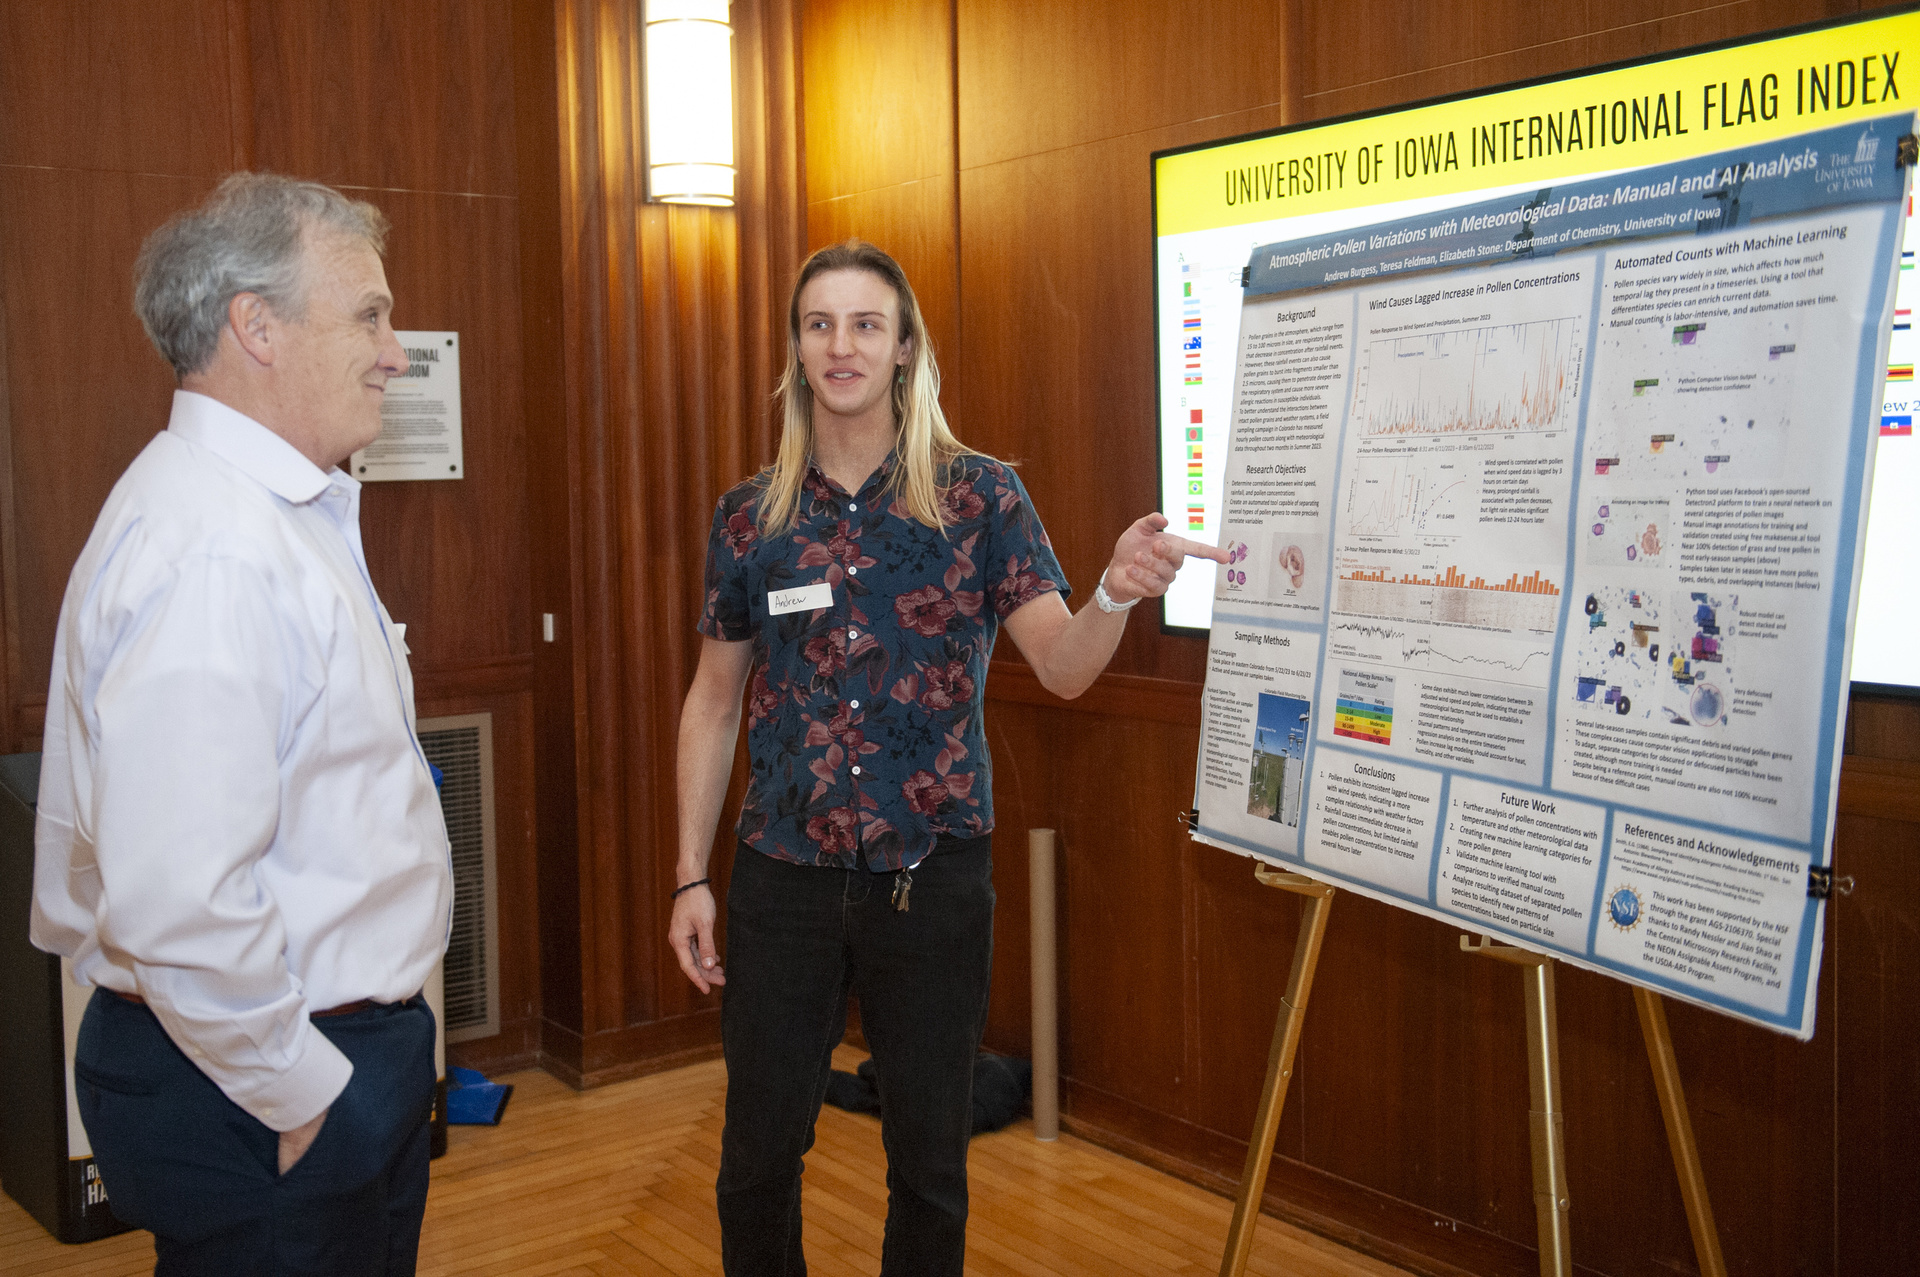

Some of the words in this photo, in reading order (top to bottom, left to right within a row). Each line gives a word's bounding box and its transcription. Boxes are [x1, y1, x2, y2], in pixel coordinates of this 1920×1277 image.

[1226, 150, 1347, 206] UNIVERSITY
[1358, 144, 1383, 185] OF
[1396, 131, 1459, 180] IOWA
[1472, 89, 1688, 168] INTERNATIONAL
[1703, 73, 1778, 131] FLAG
[1797, 51, 1900, 116] INDEX
[1831, 153, 1850, 167] THE
[1815, 164, 1875, 183] UNIVERSITY
[1827, 181, 1838, 193] OF
[1844, 177, 1873, 191] IOWA
[1268, 244, 1331, 269] Atmospheric
[1331, 236, 1367, 255] Pollen
[1367, 229, 1426, 249] Variations
[1427, 217, 1459, 240] with
[1459, 196, 1566, 232] Meteorological
[1566, 189, 1611, 213] Data:
[1611, 177, 1678, 205] Manual
[1678, 171, 1718, 195] and
[1717, 166, 1741, 189] AI
[1741, 152, 1819, 182] Analysis
[1323, 269, 1349, 282] Andrew
[1349, 265, 1378, 278] Burgess,
[1379, 261, 1402, 272] Teresa
[1403, 255, 1437, 268] Feldman,
[1438, 245, 1476, 263] Elizabeth
[1476, 241, 1503, 256] Stone:
[1504, 232, 1558, 252] Department
[1559, 228, 1570, 242] of
[1571, 223, 1621, 239] Chemistry,
[1623, 213, 1676, 231] University
[1678, 207, 1692, 223] of
[1693, 207, 1721, 220] Iowa
[1614, 250, 1673, 270] Automated
[1675, 247, 1713, 261] Counts
[1715, 240, 1740, 256] with
[1742, 235, 1793, 252] Machine
[1796, 227, 1846, 244] Learning
[1613, 279, 1634, 289] Pollen
[1635, 277, 1660, 287] species
[1661, 274, 1678, 282] vary
[1679, 269, 1704, 279] widely
[1731, 262, 1754, 273] which
[1756, 260, 1781, 270] affects
[1783, 257, 1801, 266] how
[1802, 252, 1824, 263] much
[1368, 298, 1387, 310] Wind
[1388, 297, 1412, 308] Causes
[1414, 290, 1440, 306] Lagged
[1441, 288, 1474, 301] Increase
[1475, 286, 1484, 296] in
[1485, 279, 1511, 293] Pollen
[1513, 271, 1580, 289] Concentrations
[1276, 308, 1316, 323] Background
[1261, 332, 1273, 340] grains
[1284, 328, 1309, 336] atmosphere,
[1309, 325, 1321, 333] which
[1677, 377, 1696, 385] Python
[1883, 401, 1908, 412] ew
[1245, 464, 1274, 473] Research
[1274, 464, 1306, 475] Objectives
[1496, 459, 1509, 467] speed
[1548, 458, 1563, 466] pollen
[1685, 488, 1705, 496] Python
[1768, 488, 1810, 496] open-sourced
[775, 594, 806, 608] Andrew
[1234, 631, 1262, 646] Sampling
[1262, 635, 1290, 646] Methods
[1357, 672, 1370, 680] Allergy
[1370, 673, 1384, 681] Bureau
[1353, 763, 1395, 781] Conclusions
[1328, 772, 1342, 782] Pollen
[1342, 776, 1361, 786] exhibits
[1361, 781, 1390, 794] inconsistent
[1390, 787, 1407, 798] lagged
[1408, 792, 1429, 803] increase
[1500, 792, 1529, 809] Future
[1531, 801, 1556, 814] Work
[1453, 799, 1458, 807] 1.
[1462, 801, 1483, 813] Further
[1484, 808, 1507, 819] analysis
[1507, 812, 1514, 821] of
[1515, 815, 1534, 825] pollen
[1535, 821, 1581, 836] concentrations
[1582, 830, 1597, 839] with
[1624, 824, 1674, 845] References
[1676, 838, 1695, 849] and
[1697, 840, 1799, 873] Acknowledgements
[1612, 897, 1638, 918] NSF
[1652, 891, 1665, 900] This
[1666, 896, 1683, 905] work
[1684, 898, 1696, 908] has
[1697, 901, 1714, 913] been
[1716, 908, 1751, 922] supported
[1752, 915, 1761, 927] by
[1762, 919, 1773, 929] the
[1775, 922, 1788, 933] NSF
[1649, 904, 1676, 918] through
[1676, 911, 1688, 920] the
[1688, 916, 1707, 925] grant
[1708, 919, 1754, 939] AGS-2106370.
[1756, 933, 1781, 946] Special
[1647, 916, 1670, 928] thanks
[1679, 924, 1700, 938] Randy
[1701, 930, 1725, 944] Nessler
[1726, 939, 1739, 948] and
[1740, 941, 1754, 952] Jian
[1755, 946, 1772, 957] Shao
[1646, 928, 1657, 937] the
[1658, 931, 1682, 945] Central
[1682, 939, 1719, 958] Microscopy
[1720, 950, 1750, 966] Research
[1751, 959, 1777, 975] Facility,
[1642, 953, 1653, 963] the
[1654, 957, 1686, 973] USDA-ARS
[1687, 967, 1715, 982] Program.
[1644, 941, 1655, 950] the
[1656, 944, 1676, 956] NEON
[1676, 950, 1710, 966] Assignable
[1711, 960, 1732, 973] Assets
[1733, 967, 1764, 984] Program,
[1765, 979, 1781, 988] and
